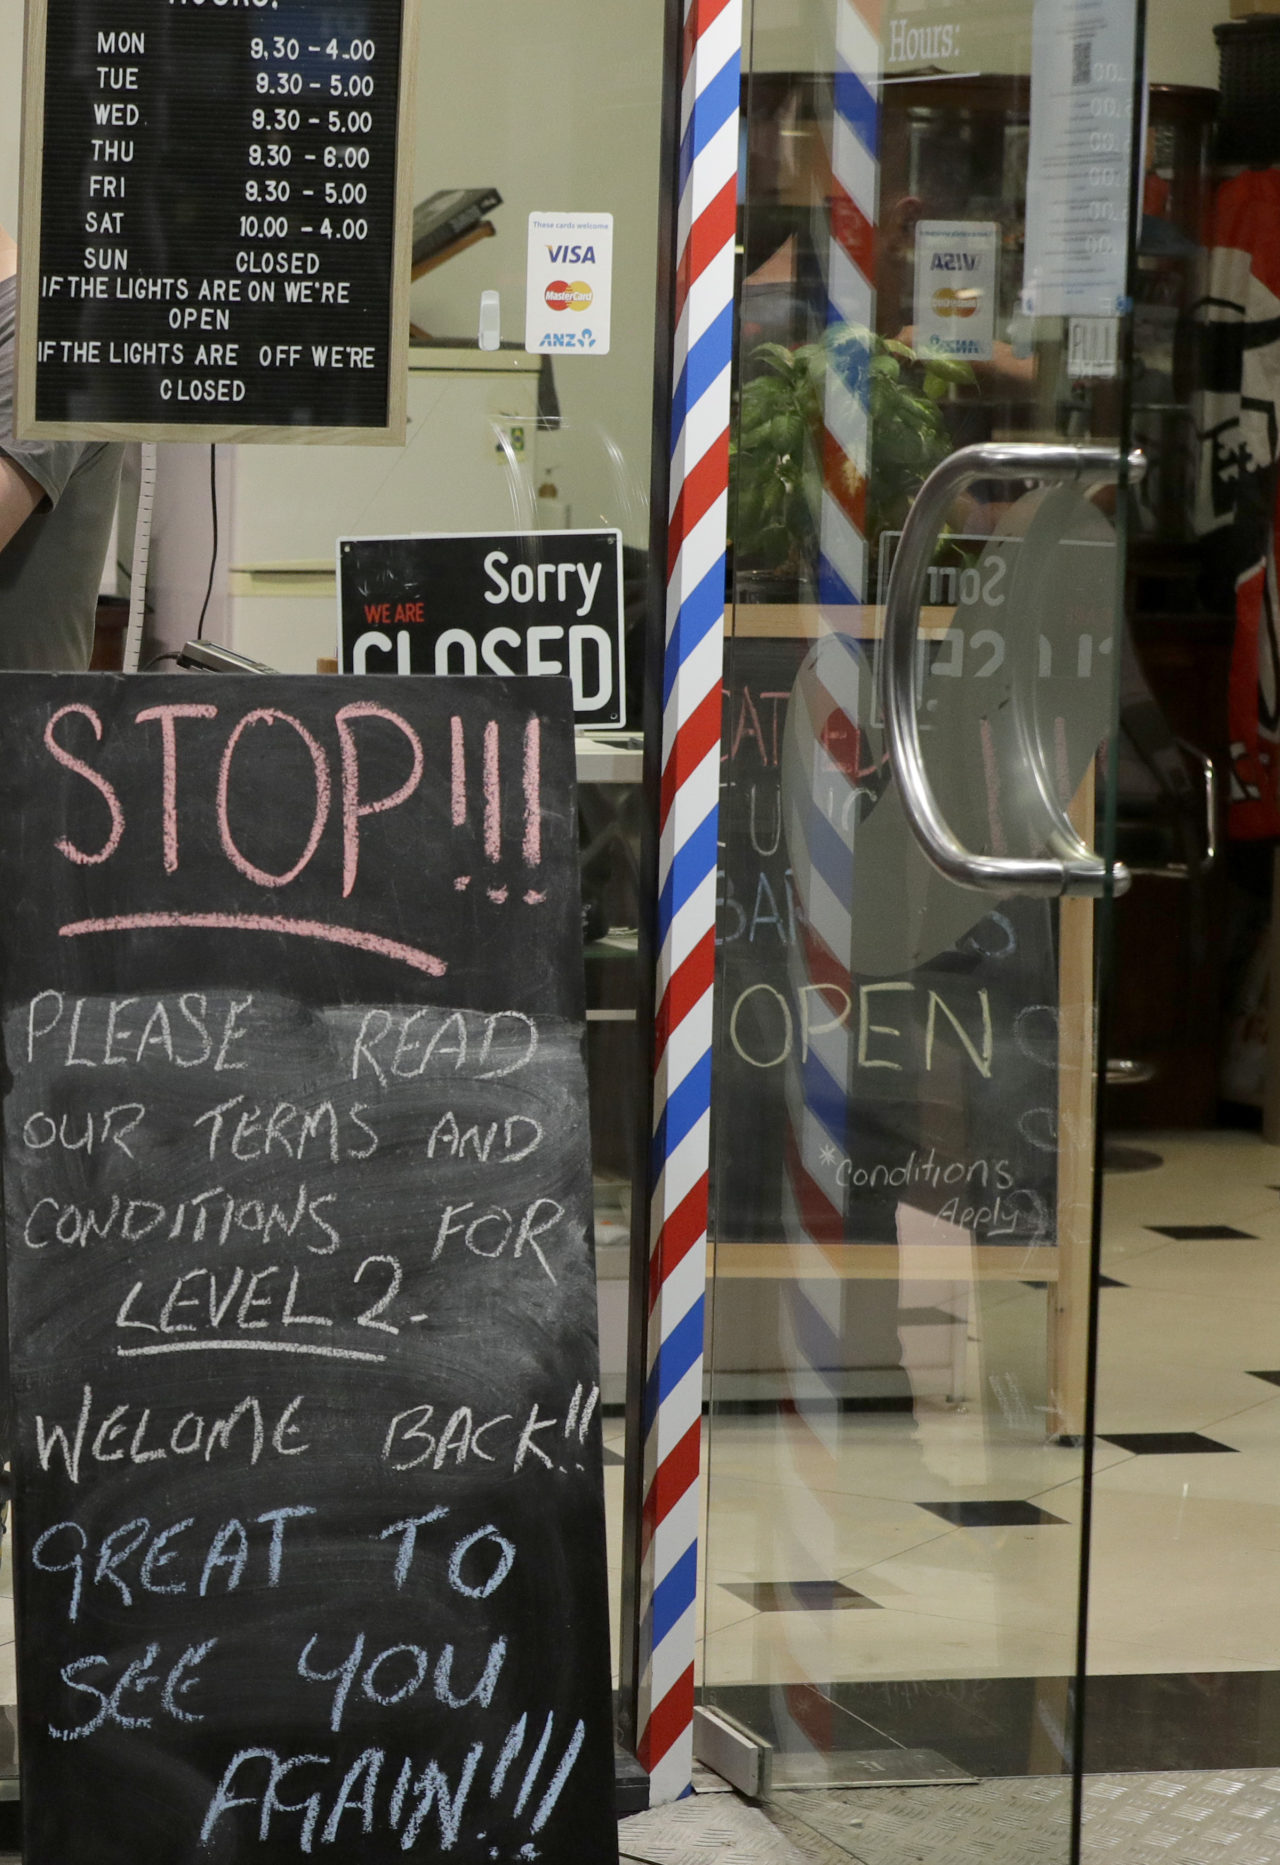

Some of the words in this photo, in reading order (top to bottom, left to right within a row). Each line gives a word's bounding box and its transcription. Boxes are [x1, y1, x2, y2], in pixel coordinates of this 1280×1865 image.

[97, 32, 145, 54] MON
[888, 18, 961, 63] Hours:
[97, 67, 139, 90] TUE
[256, 72, 302, 94] 9.30
[330, 74, 374, 97] 5.00
[94, 103, 140, 126] WED
[252, 108, 300, 131] 9.30
[328, 110, 372, 133] 5.00
[91, 140, 134, 162] THU
[248, 144, 292, 167] 9.30
[323, 146, 370, 169] 6.00
[89, 176, 125, 198] FRI
[245, 180, 290, 202] 9.30
[325, 182, 368, 205] 5.00
[85, 211, 125, 234] SAT
[240, 215, 288, 238] 10.00
[320, 217, 368, 240] 4.00
[83, 248, 128, 271] SUN
[235, 251, 320, 275] CLOSED
[544, 244, 596, 264] VISA
[42, 276, 64, 298] IF
[67, 276, 109, 299] THE
[116, 277, 189, 300] LIGHTS
[198, 279, 241, 302] ARE
[248, 281, 275, 303] ON
[284, 282, 351, 305] WE'RE
[545, 290, 593, 302] MasterCard
[168, 307, 230, 331] OPEN
[37, 341, 57, 363] IF
[60, 341, 102, 364] THE
[109, 342, 184, 365] LIGHTS
[194, 344, 239, 366] ARE
[259, 345, 303, 368] OFF
[311, 346, 376, 369] WE'RE
[539, 332, 577, 348] ANZ
[160, 378, 246, 402] CLOSED
[483, 551, 602, 616] Sorry
[364, 604, 391, 624] WE
[394, 602, 425, 623] ARE
[44, 701, 548, 904] STOP!!!
[28, 989, 253, 1071] PLEASE
[352, 1008, 539, 1088] READ
[729, 982, 992, 1079] OPEN
[23, 1102, 145, 1158] OUR
[194, 1094, 379, 1164] TERMS
[426, 1110, 543, 1163] AND
[23, 1184, 341, 1255] CONDITIONS
[431, 1197, 566, 1286] FOR
[116, 1265, 333, 1333] LEVEL
[382, 1381, 600, 1473] BACK!!
[31, 1504, 317, 1624] GREAT
[376, 1504, 517, 1600] TO
[47, 1636, 219, 1742] SEE
[296, 1632, 508, 1733] YOU
[197, 1709, 587, 1863] AGAIN!!!
